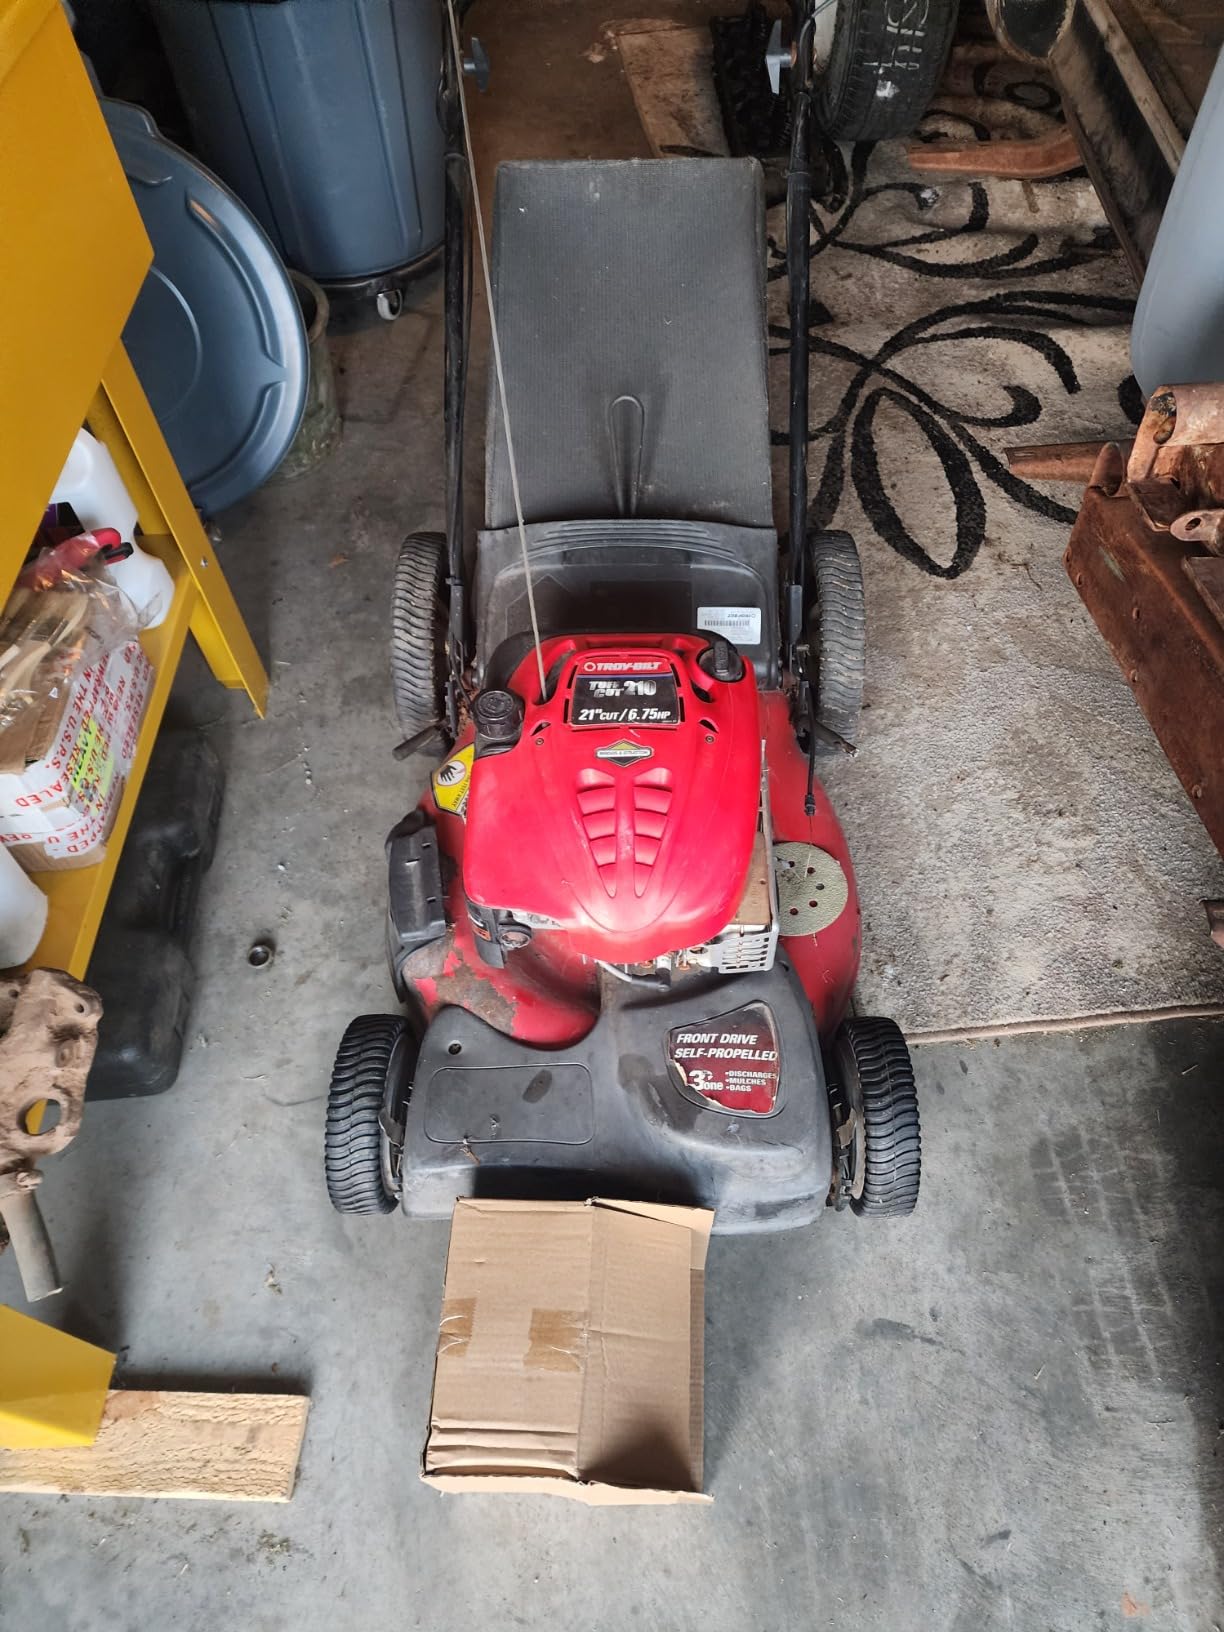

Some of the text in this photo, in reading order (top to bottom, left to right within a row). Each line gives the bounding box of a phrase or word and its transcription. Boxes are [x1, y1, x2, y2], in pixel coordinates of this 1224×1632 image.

[596, 661, 663, 671] TROY-BILT
[623, 679, 657, 696] 210
[73, 683, 88, 714] THE
[45, 715, 78, 770] U.S.P.S.
[16, 742, 82, 808] RESEALED
[676, 1033, 758, 1045] FRONT DRIVE
[674, 1047, 778, 1061] SELF-PROPELLED
